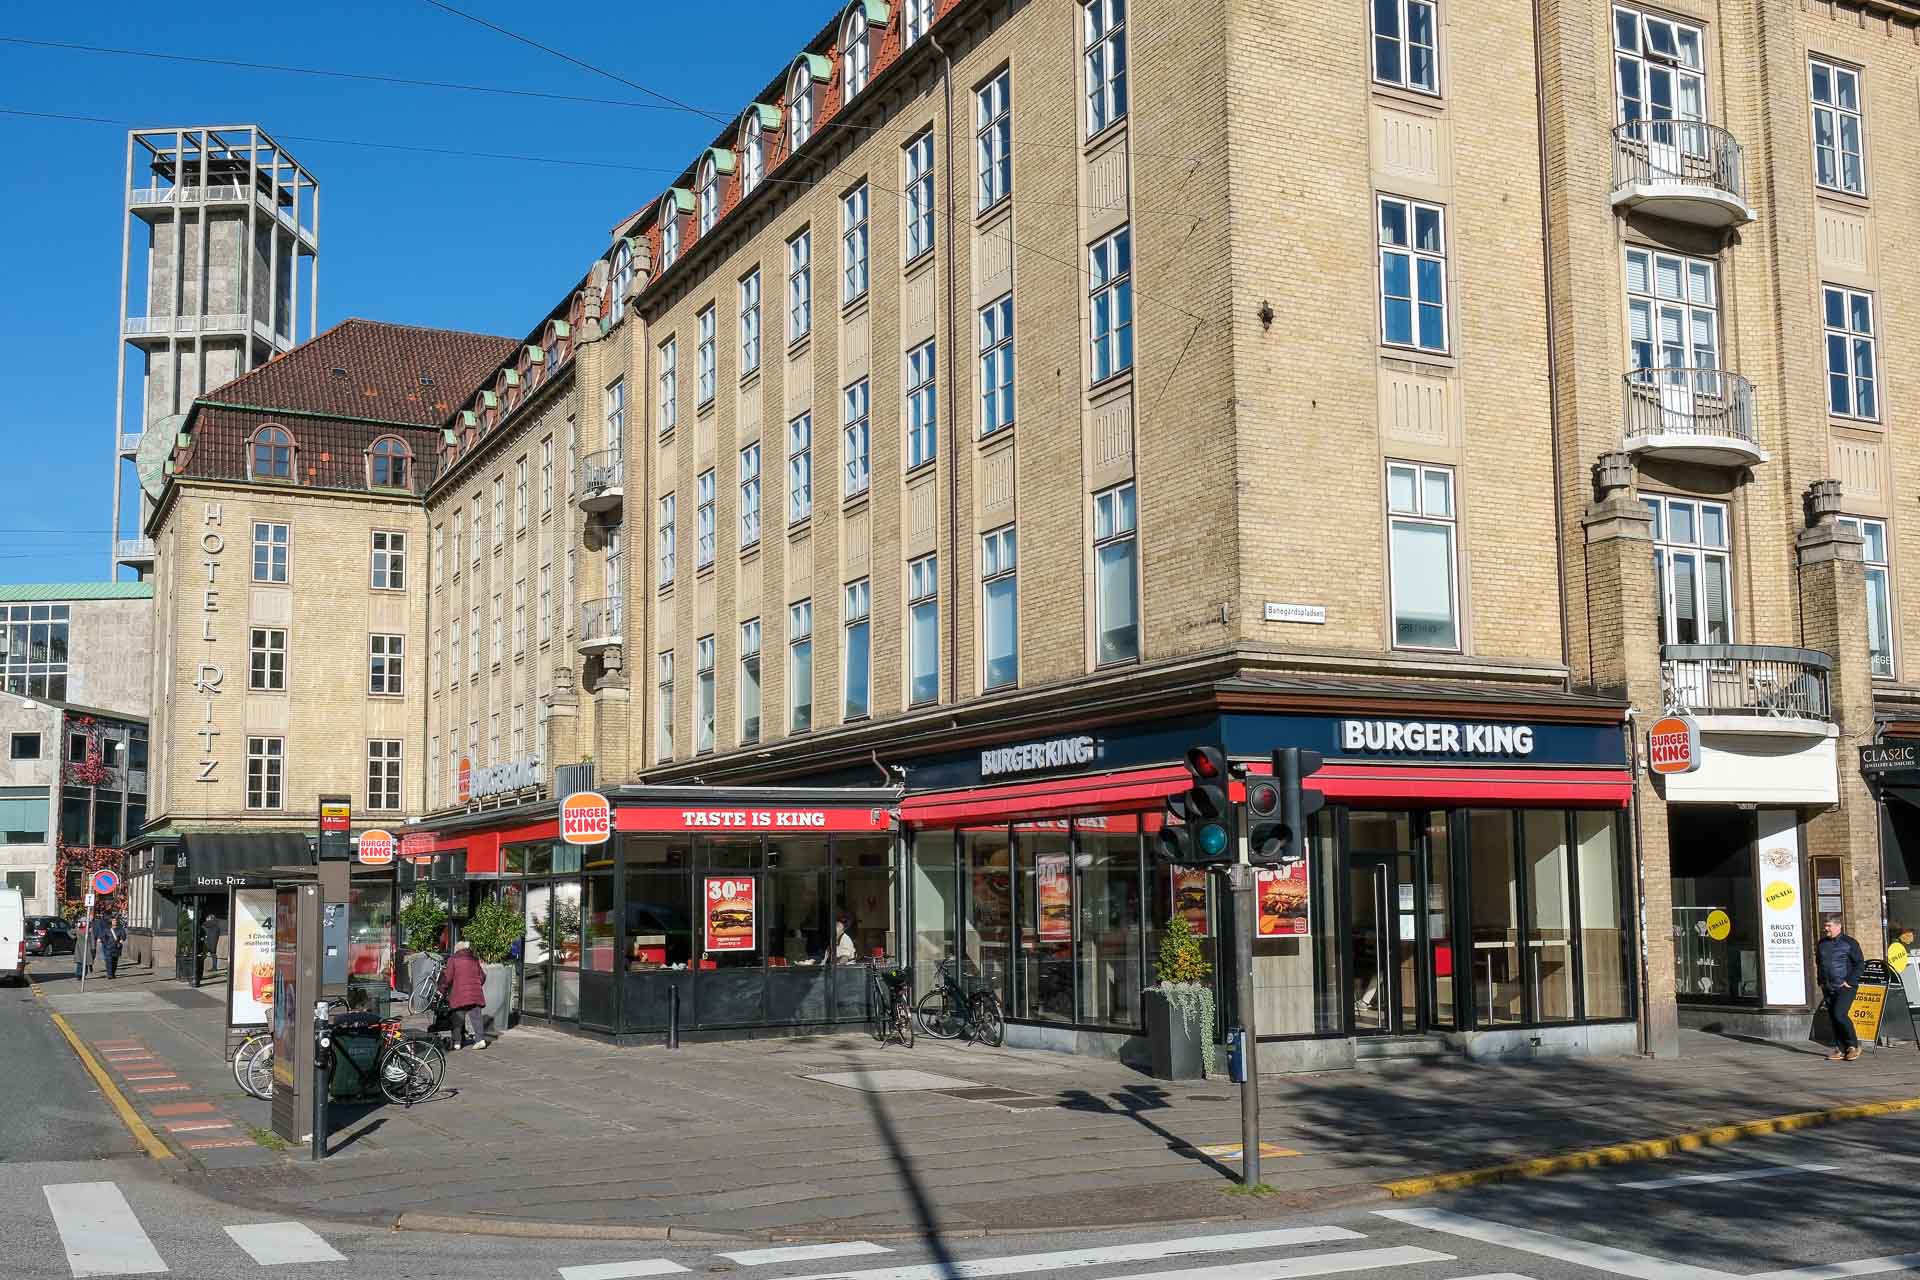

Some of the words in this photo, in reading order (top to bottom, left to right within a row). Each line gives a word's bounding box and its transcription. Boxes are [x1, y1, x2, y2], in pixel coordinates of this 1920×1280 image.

[201, 503, 224, 641] HOTEL
[194, 663, 224, 782] RITZ
[1343, 720, 1459, 751] BURGER
[1465, 724, 1534, 754] KING
[1651, 733, 1688, 747] BURGER
[981, 743, 1045, 776] BURGER
[1045, 736, 1094, 768] KING
[1652, 744, 1690, 762] KING
[1863, 747, 1915, 763] CLASSIC
[564, 808, 608, 818] BURGER
[682, 812, 746, 826] TASTE
[752, 812, 771, 826] IS
[776, 812, 825, 826] KING
[565, 818, 608, 833] KING
[360, 847, 391, 857] KING
[197, 877, 223, 886] HOTEL
[226, 876, 246, 885] RITZ
[1770, 923, 1795, 931] BRUGT
